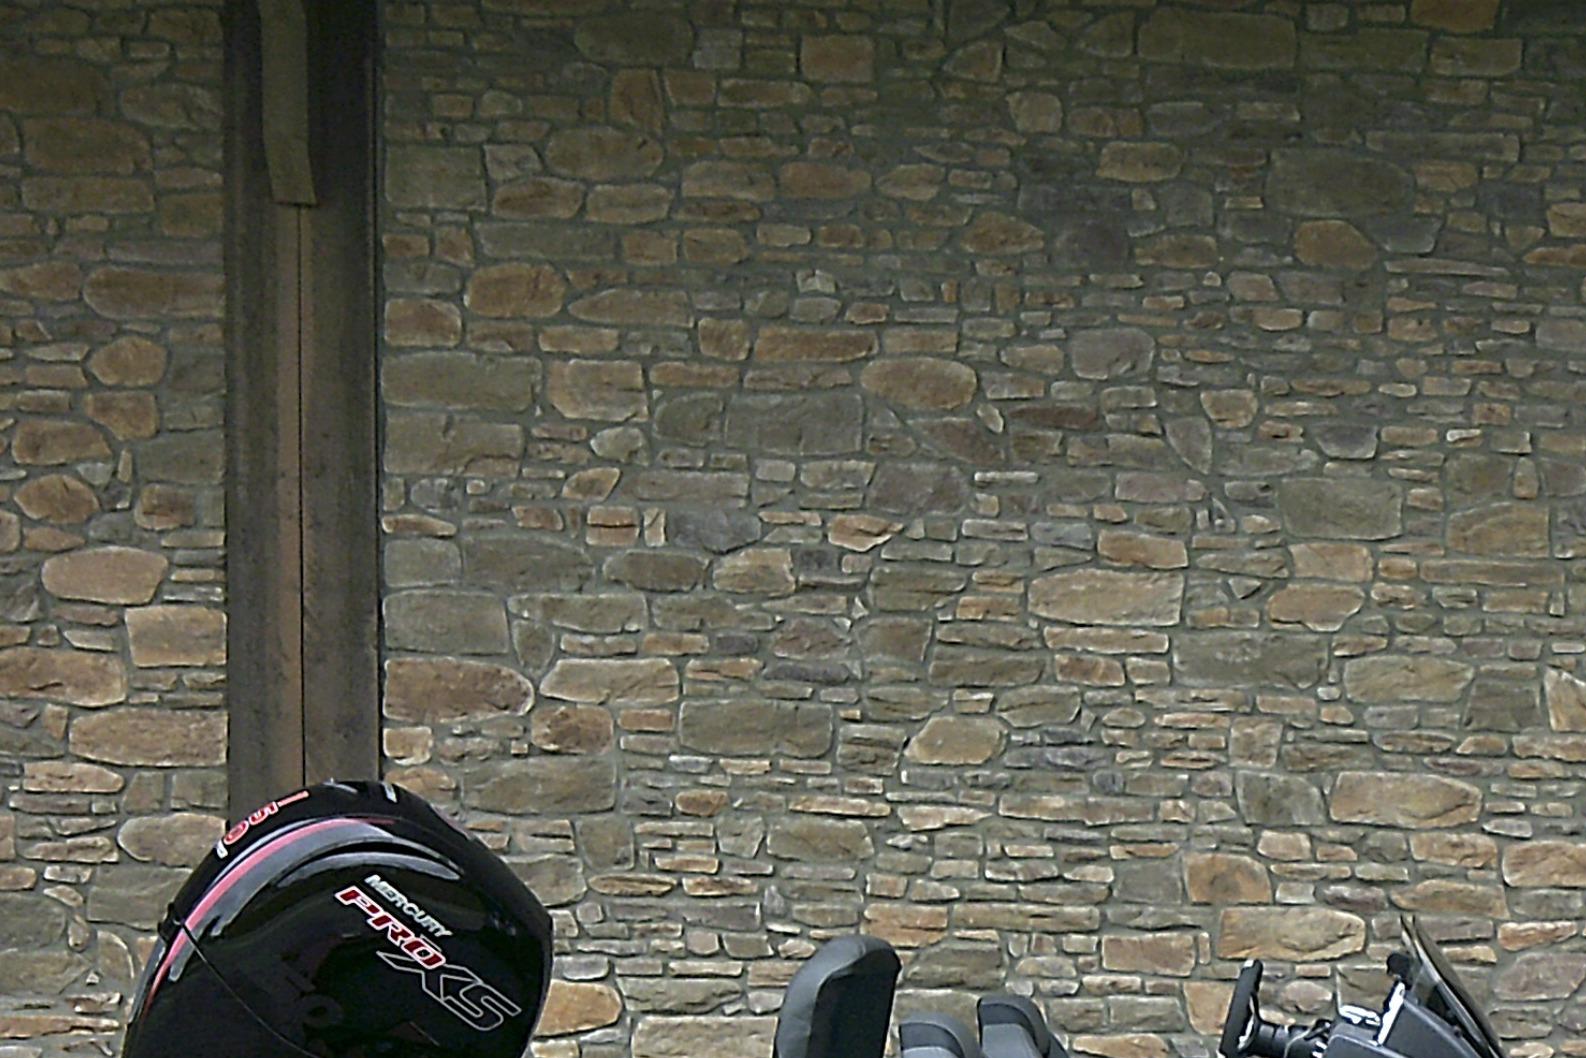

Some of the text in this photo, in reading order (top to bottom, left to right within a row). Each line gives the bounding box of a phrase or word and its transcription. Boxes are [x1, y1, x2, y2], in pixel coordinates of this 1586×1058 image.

[364, 874, 454, 937] MERCURY
[334, 885, 522, 1031] PRO XS
